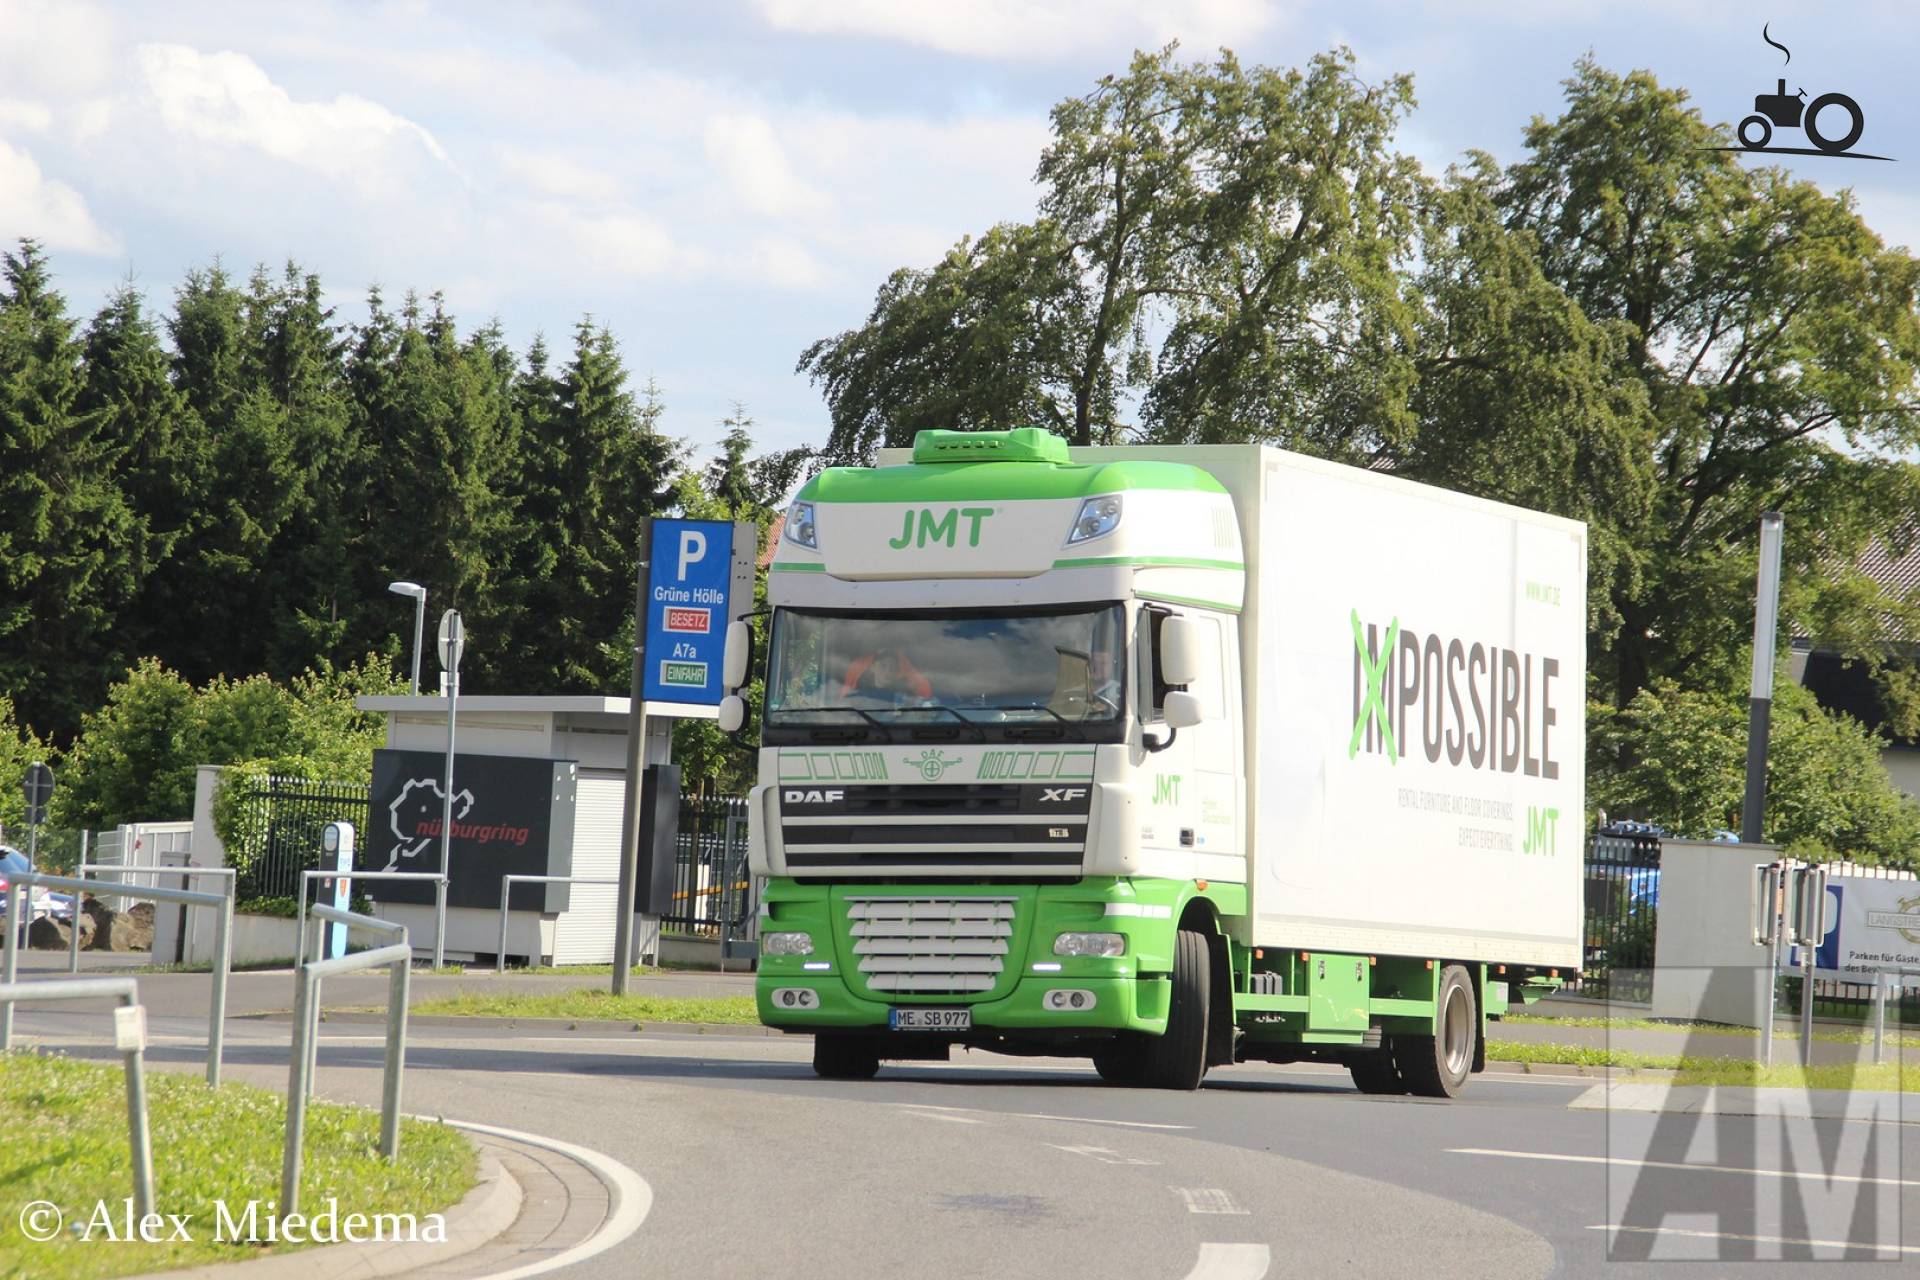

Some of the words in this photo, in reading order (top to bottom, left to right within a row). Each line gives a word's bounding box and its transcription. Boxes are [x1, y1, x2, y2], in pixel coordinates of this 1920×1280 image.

[889, 507, 995, 549] JMT
[677, 530, 707, 582] P
[654, 586, 690, 602] Grüne
[693, 588, 724, 604] Hölle
[670, 612, 707, 628] BESETZ
[672, 642, 697, 659] A7a
[784, 789, 844, 803] DAF
[1039, 788, 1087, 801] XF
[1152, 773, 1181, 806] JMT
[416, 818, 530, 847] nüburgring
[1523, 806, 1559, 857] JMT
[1849, 950, 1879, 961] Parken
[1881, 953, 1894, 963] für
[897, 1012, 915, 1025] ME
[924, 1012, 941, 1025] SB
[944, 1012, 968, 1025] 977
